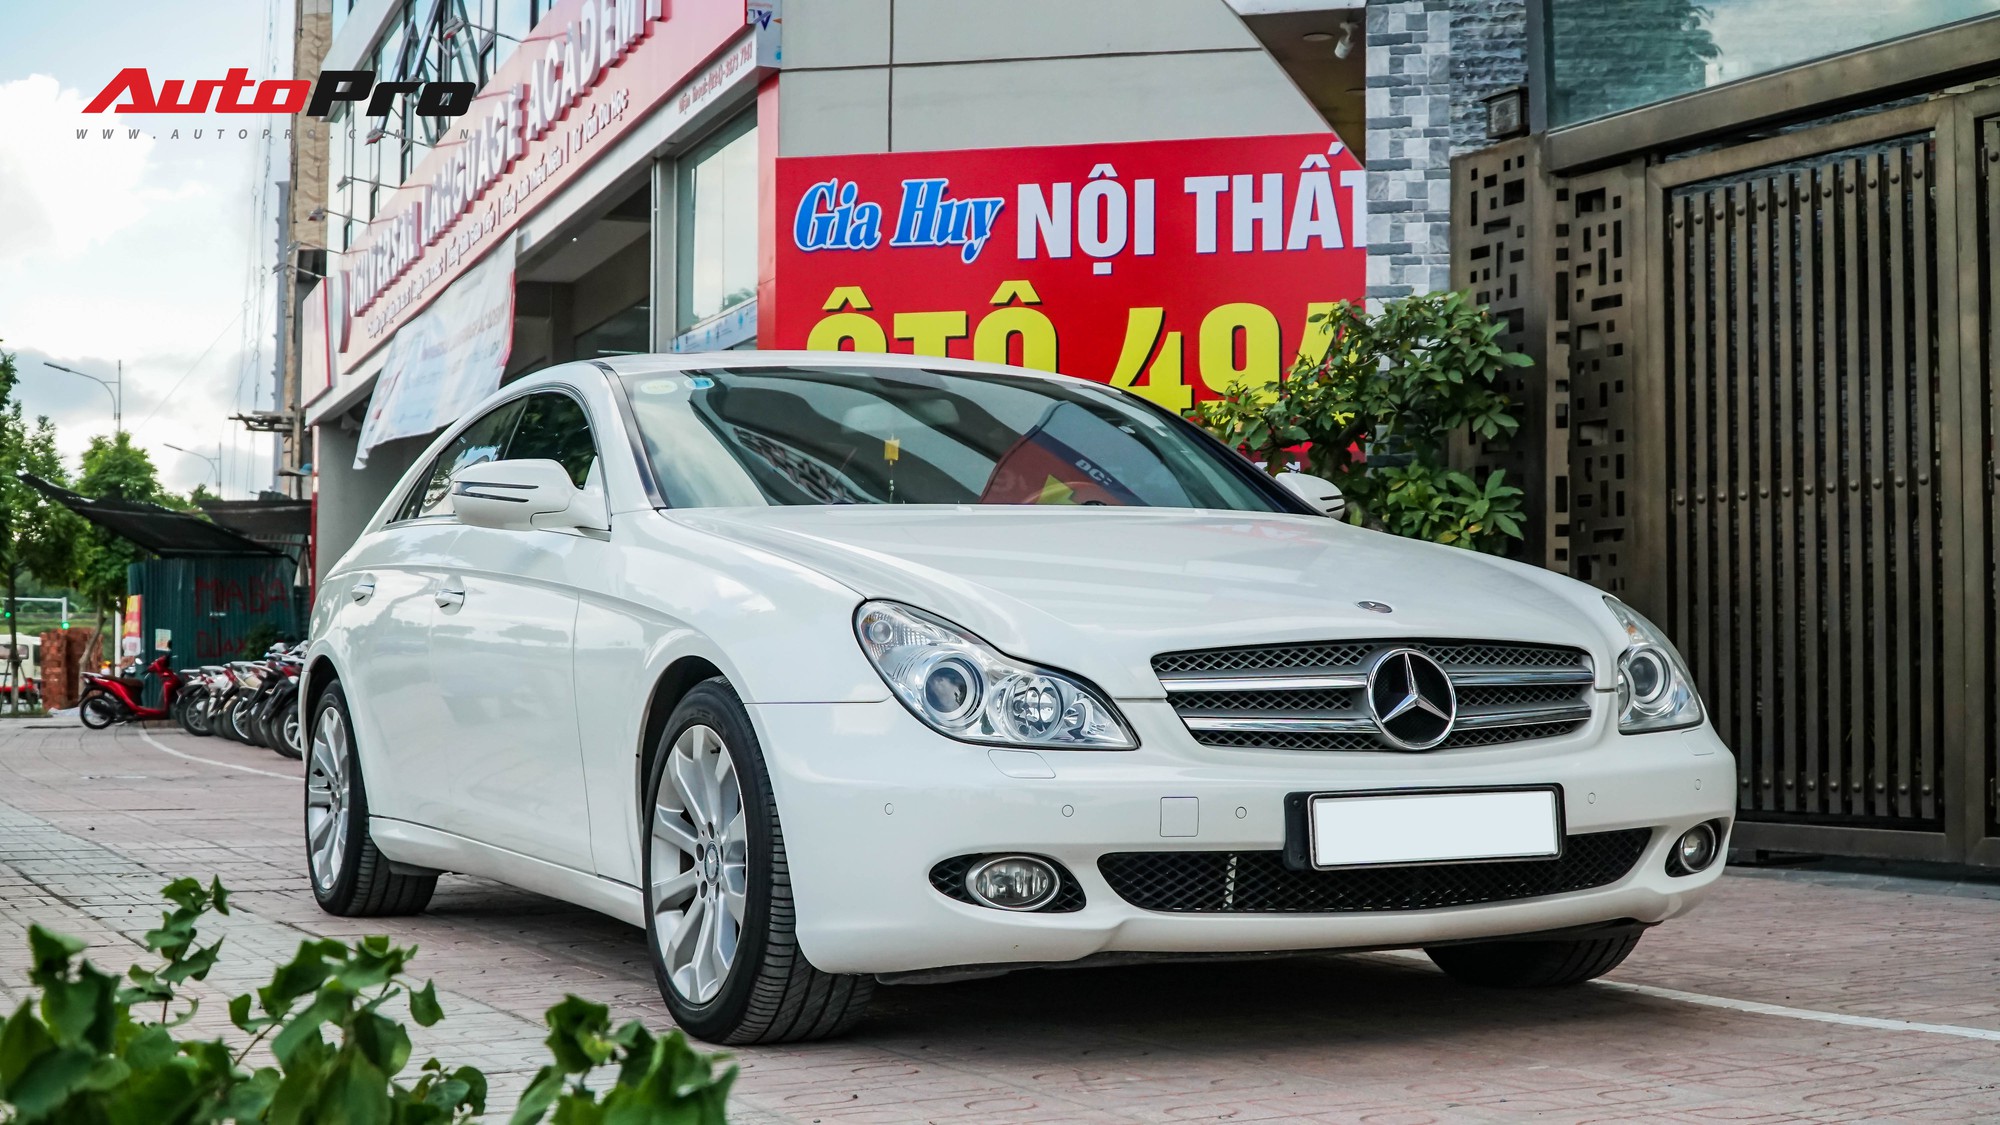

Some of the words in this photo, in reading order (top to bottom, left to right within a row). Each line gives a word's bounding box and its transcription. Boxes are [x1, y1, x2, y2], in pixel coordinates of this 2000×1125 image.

[350, 201, 421, 317] UNIVERSAL
[421, 84, 523, 248] LANGUAGE
[527, 0, 663, 141] ACADEM
[793, 177, 882, 252] Gia
[890, 177, 1005, 265] Huy
[1016, 163, 1156, 275] NỘI
